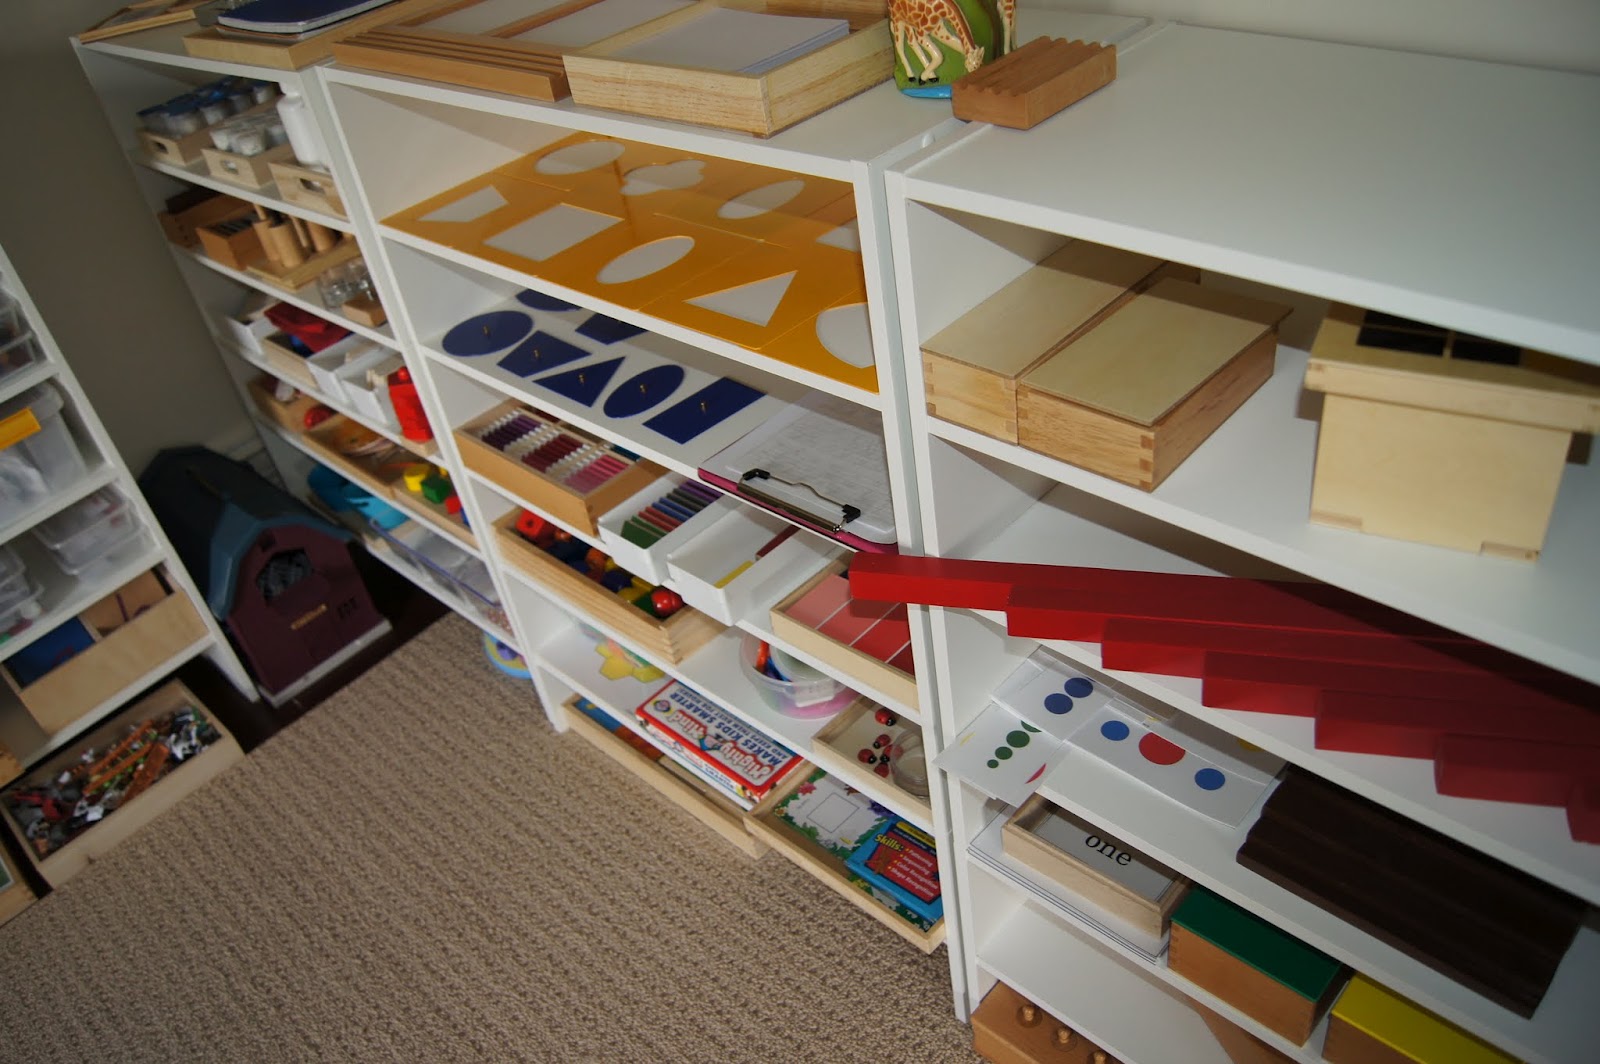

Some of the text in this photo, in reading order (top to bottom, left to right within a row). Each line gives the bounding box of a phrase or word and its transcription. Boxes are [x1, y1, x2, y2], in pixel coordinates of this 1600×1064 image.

[666, 707, 707, 738] Mind
[670, 692, 782, 766] MAKES KIDS SMARTER
[718, 740, 774, 780] Mighty
[770, 748, 788, 759] AND
[908, 850, 933, 867] Patterning
[1086, 835, 1132, 866] one
[890, 867, 933, 897] Shape Recognition
[896, 862, 938, 889] Color Recognition
